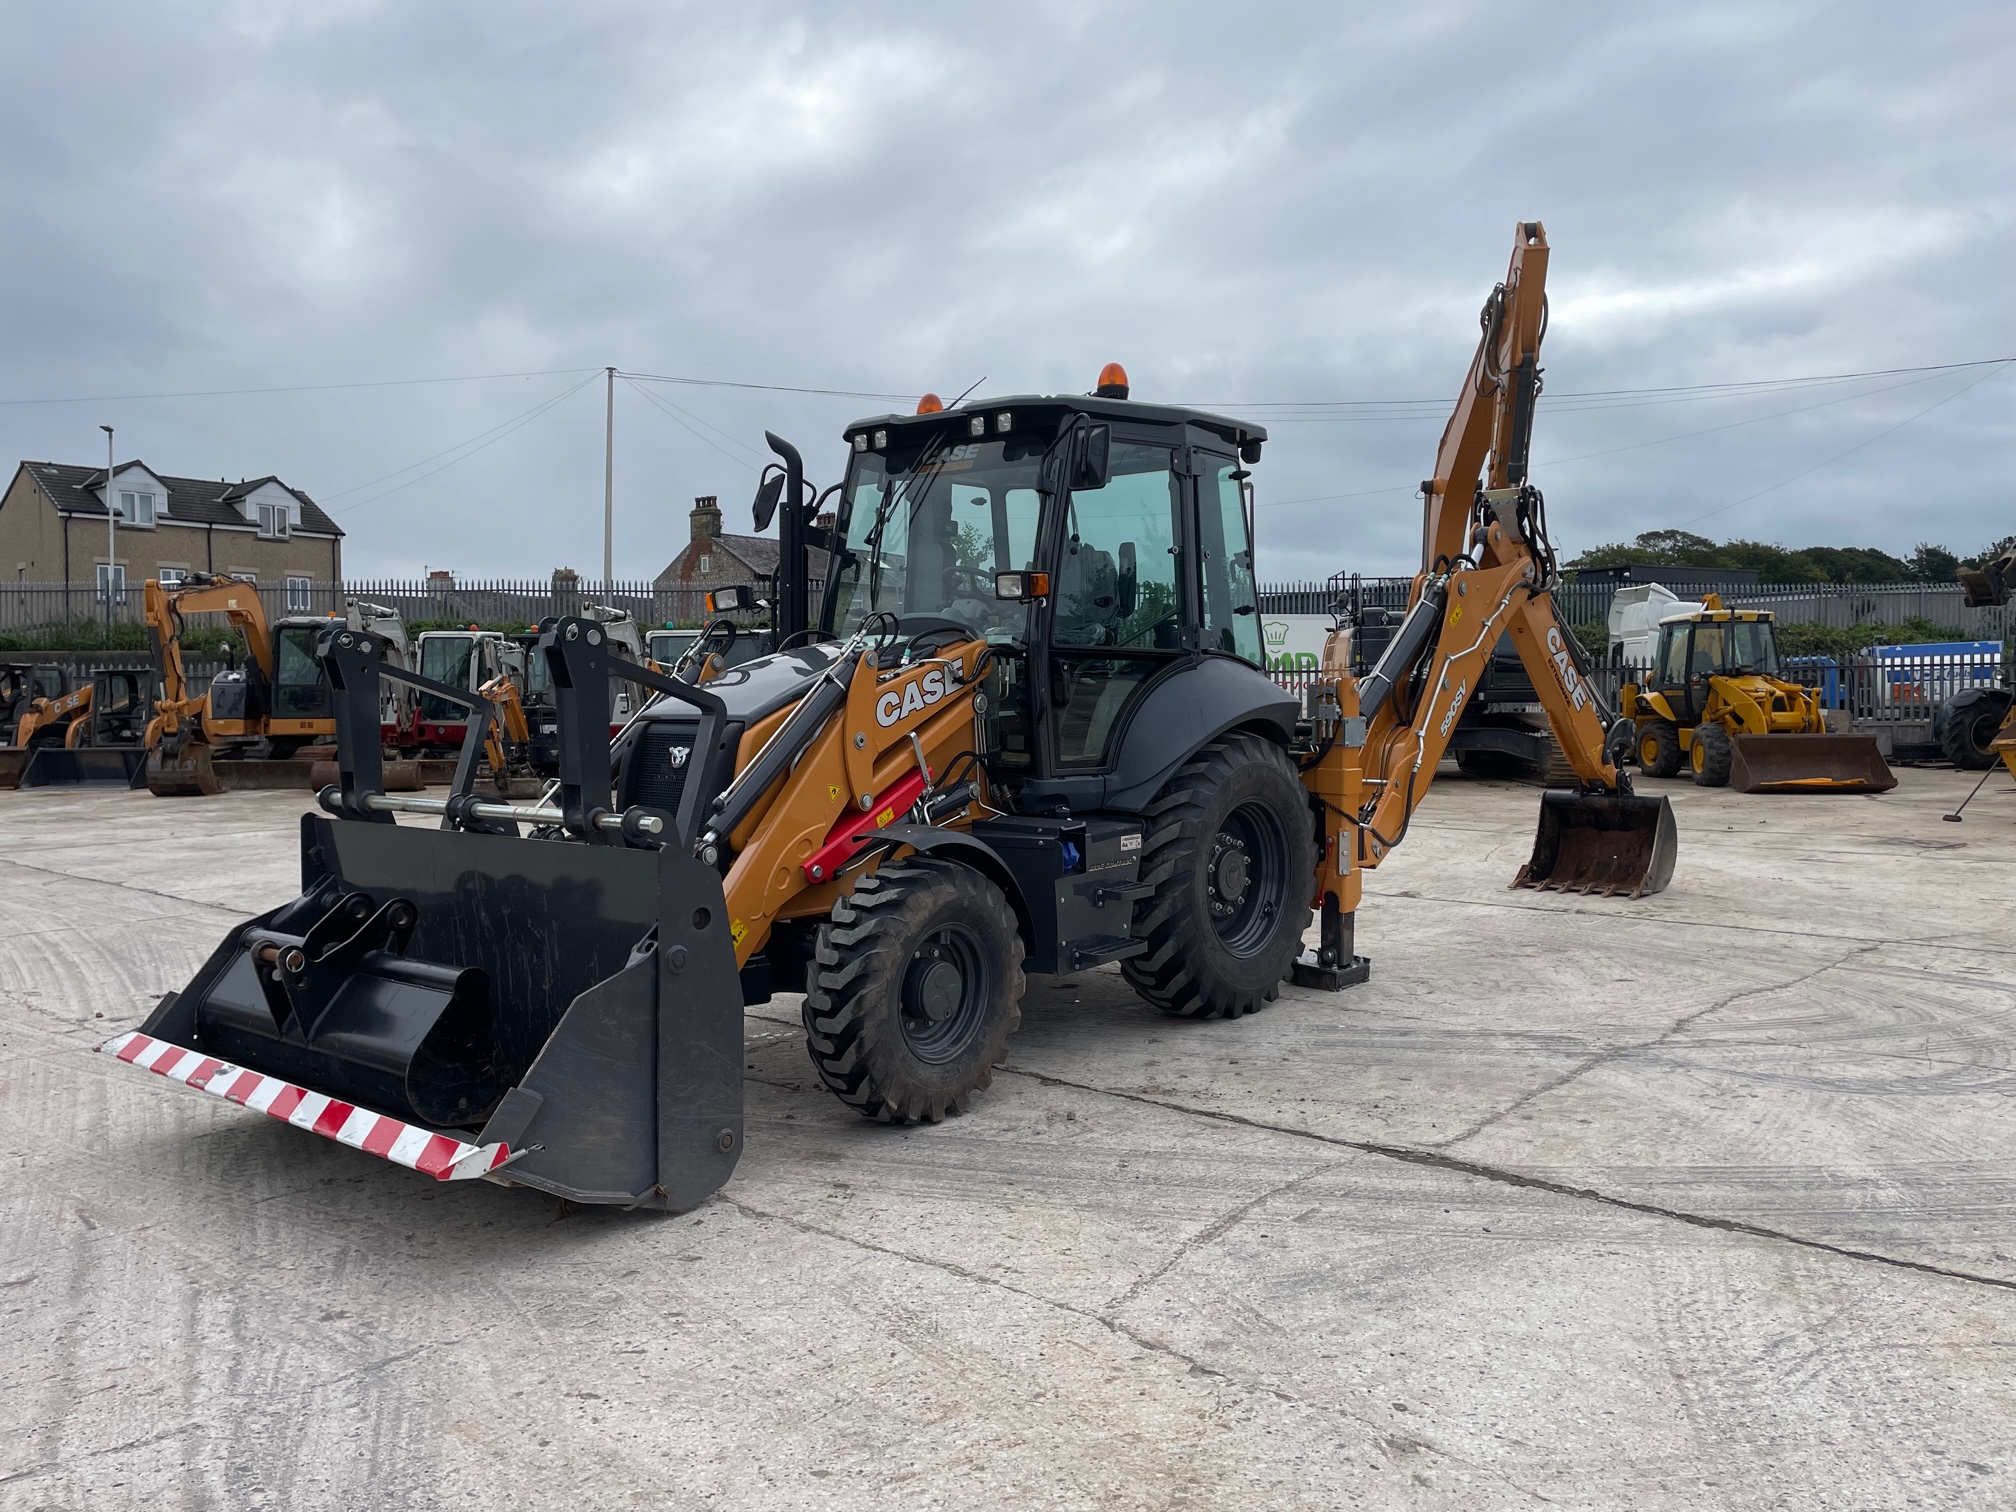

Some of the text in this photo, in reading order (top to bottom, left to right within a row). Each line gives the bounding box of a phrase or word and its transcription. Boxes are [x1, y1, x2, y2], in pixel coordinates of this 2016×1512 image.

[876, 657, 964, 728] CASE
[1546, 625, 1587, 713] CASE
[54, 694, 80, 713] CSE
[1440, 676, 1466, 738] 590SV
